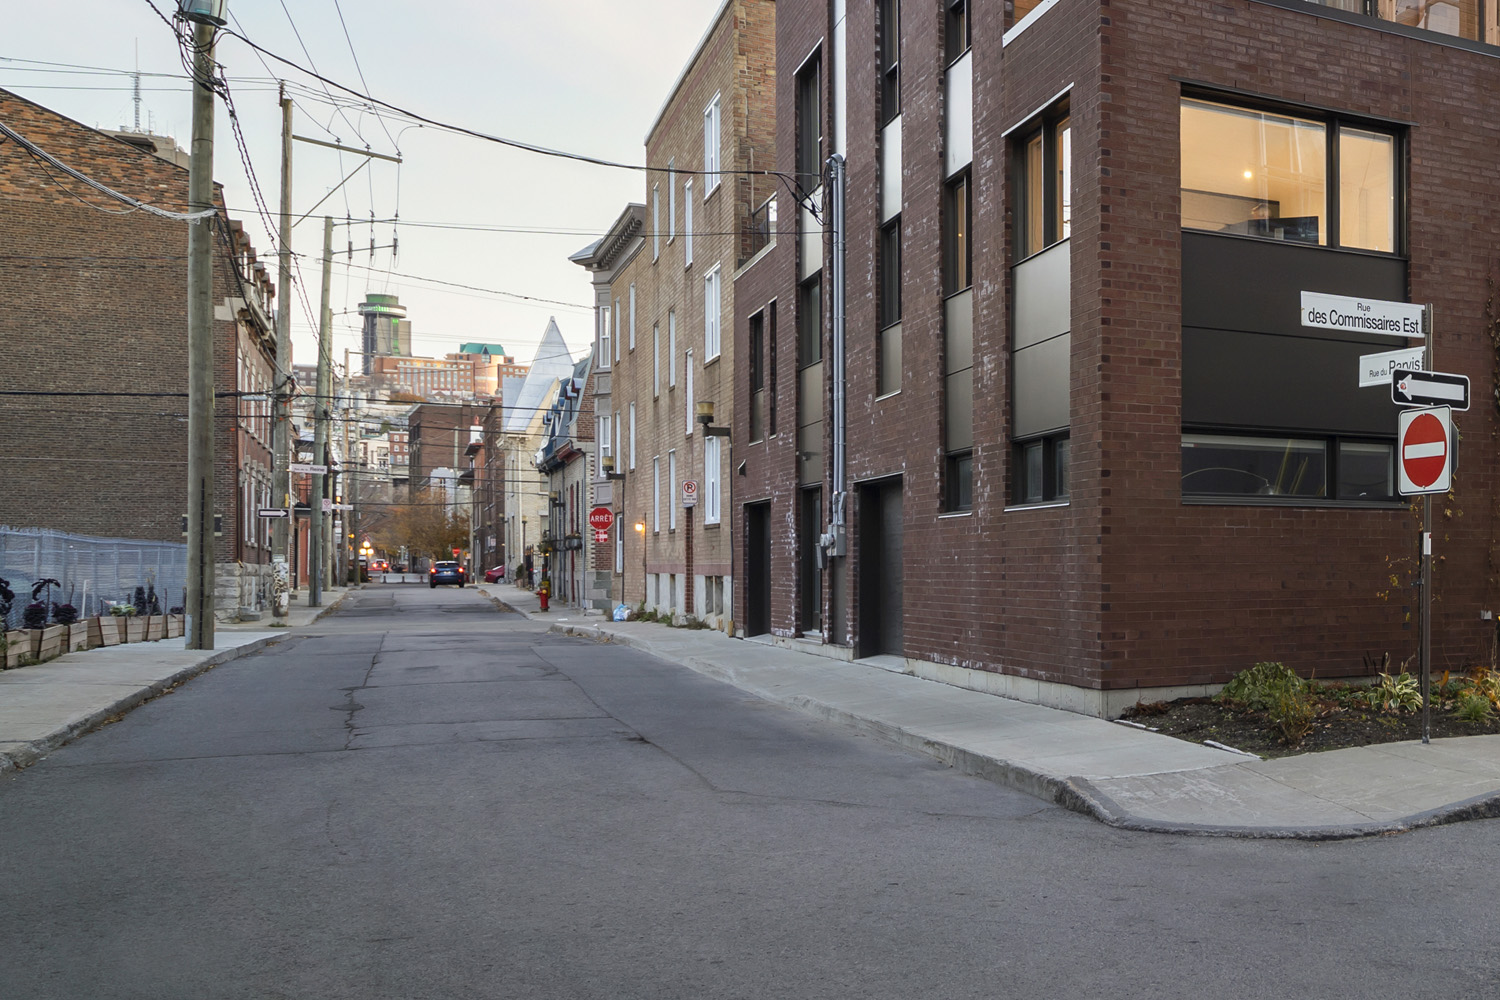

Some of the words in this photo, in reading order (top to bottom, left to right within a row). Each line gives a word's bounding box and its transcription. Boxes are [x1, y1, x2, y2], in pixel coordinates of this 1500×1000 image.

[1357, 302, 1371, 312] Rue
[1308, 307, 1327, 324] des
[1329, 309, 1400, 332] Commissaires
[1403, 317, 1419, 334] Est
[1369, 369, 1379, 378] Rue
[1380, 368, 1387, 376] du
[590, 514, 612, 523] ARRÊT
